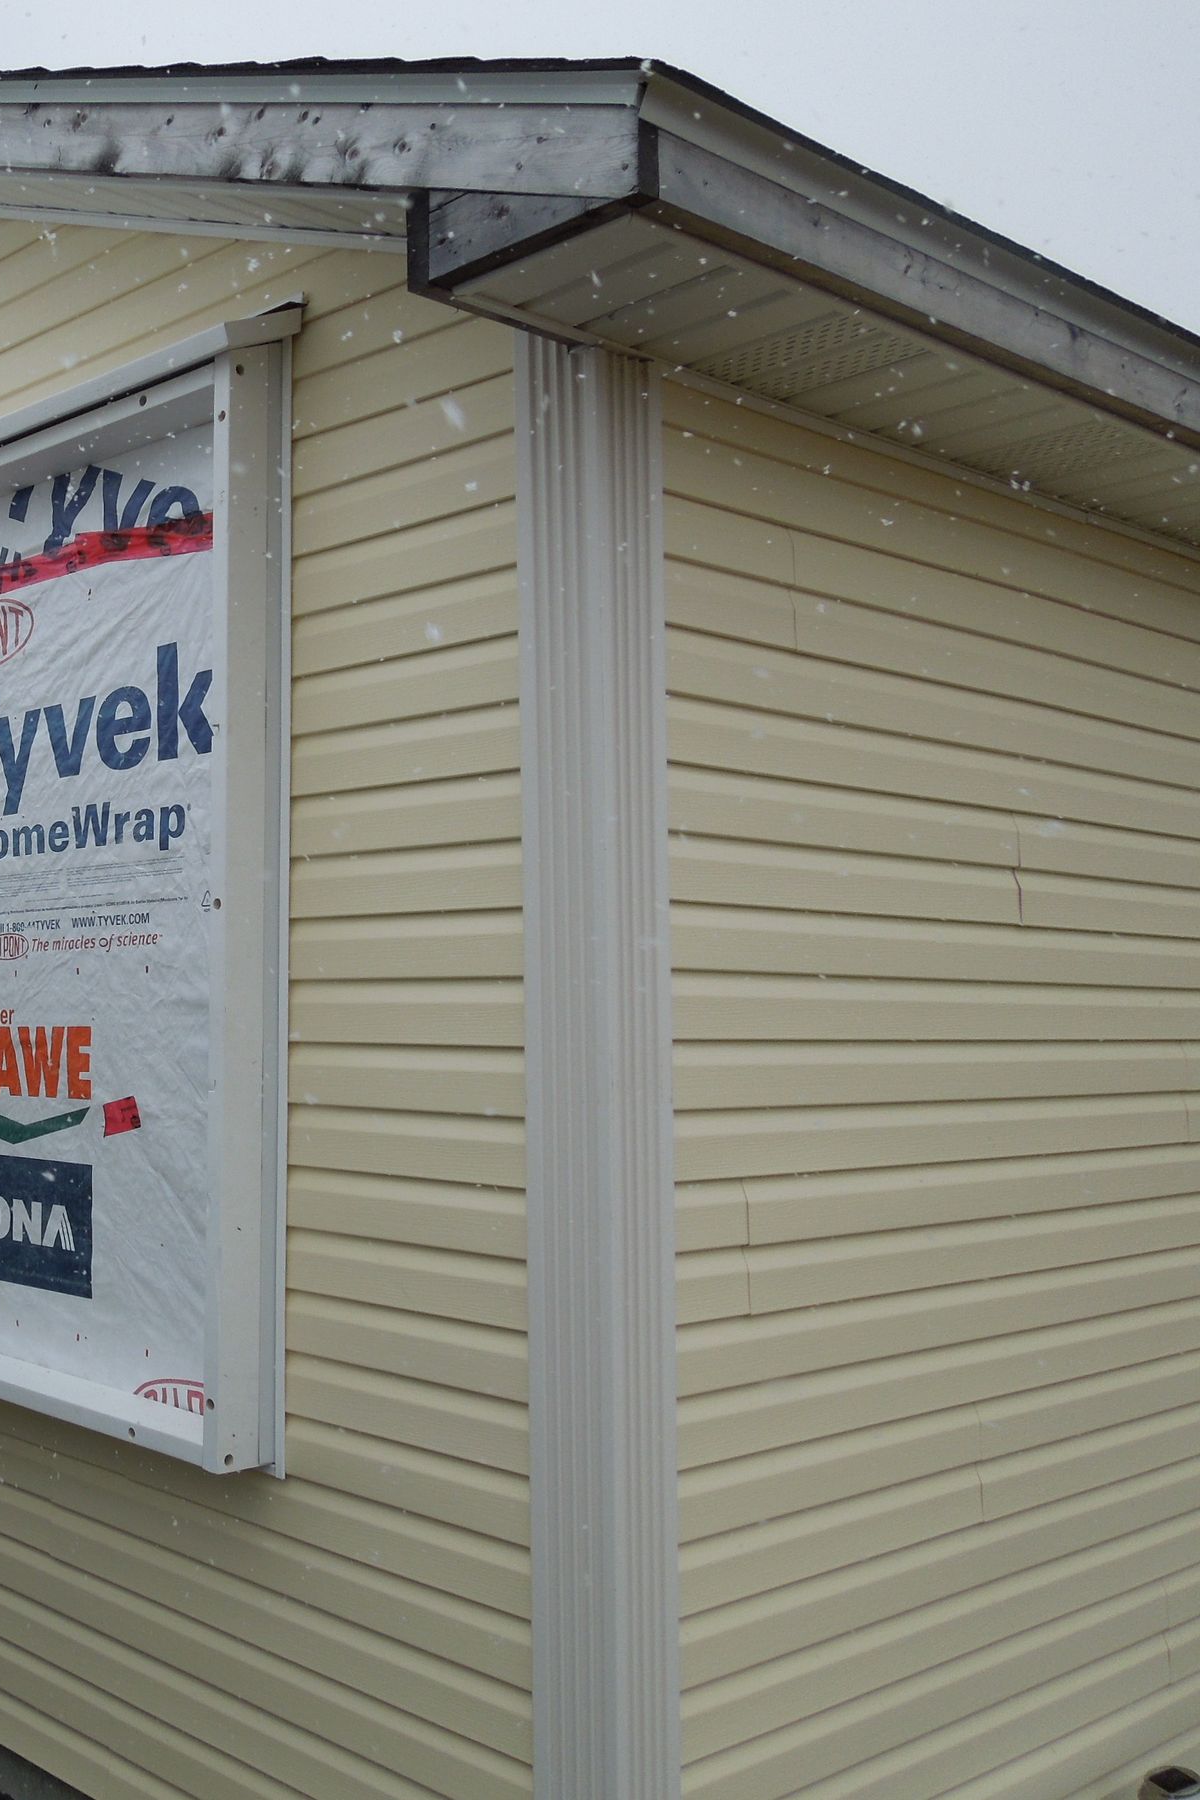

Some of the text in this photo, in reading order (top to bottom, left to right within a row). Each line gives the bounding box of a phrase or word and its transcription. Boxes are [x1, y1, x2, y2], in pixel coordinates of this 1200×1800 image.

[8, 464, 207, 556] yve
[71, 912, 150, 929] WWW.TYVEK.COM
[31, 938, 50, 952] The
[52, 936, 96, 951] miracles
[98, 933, 114, 953] of
[116, 931, 158, 948] science
